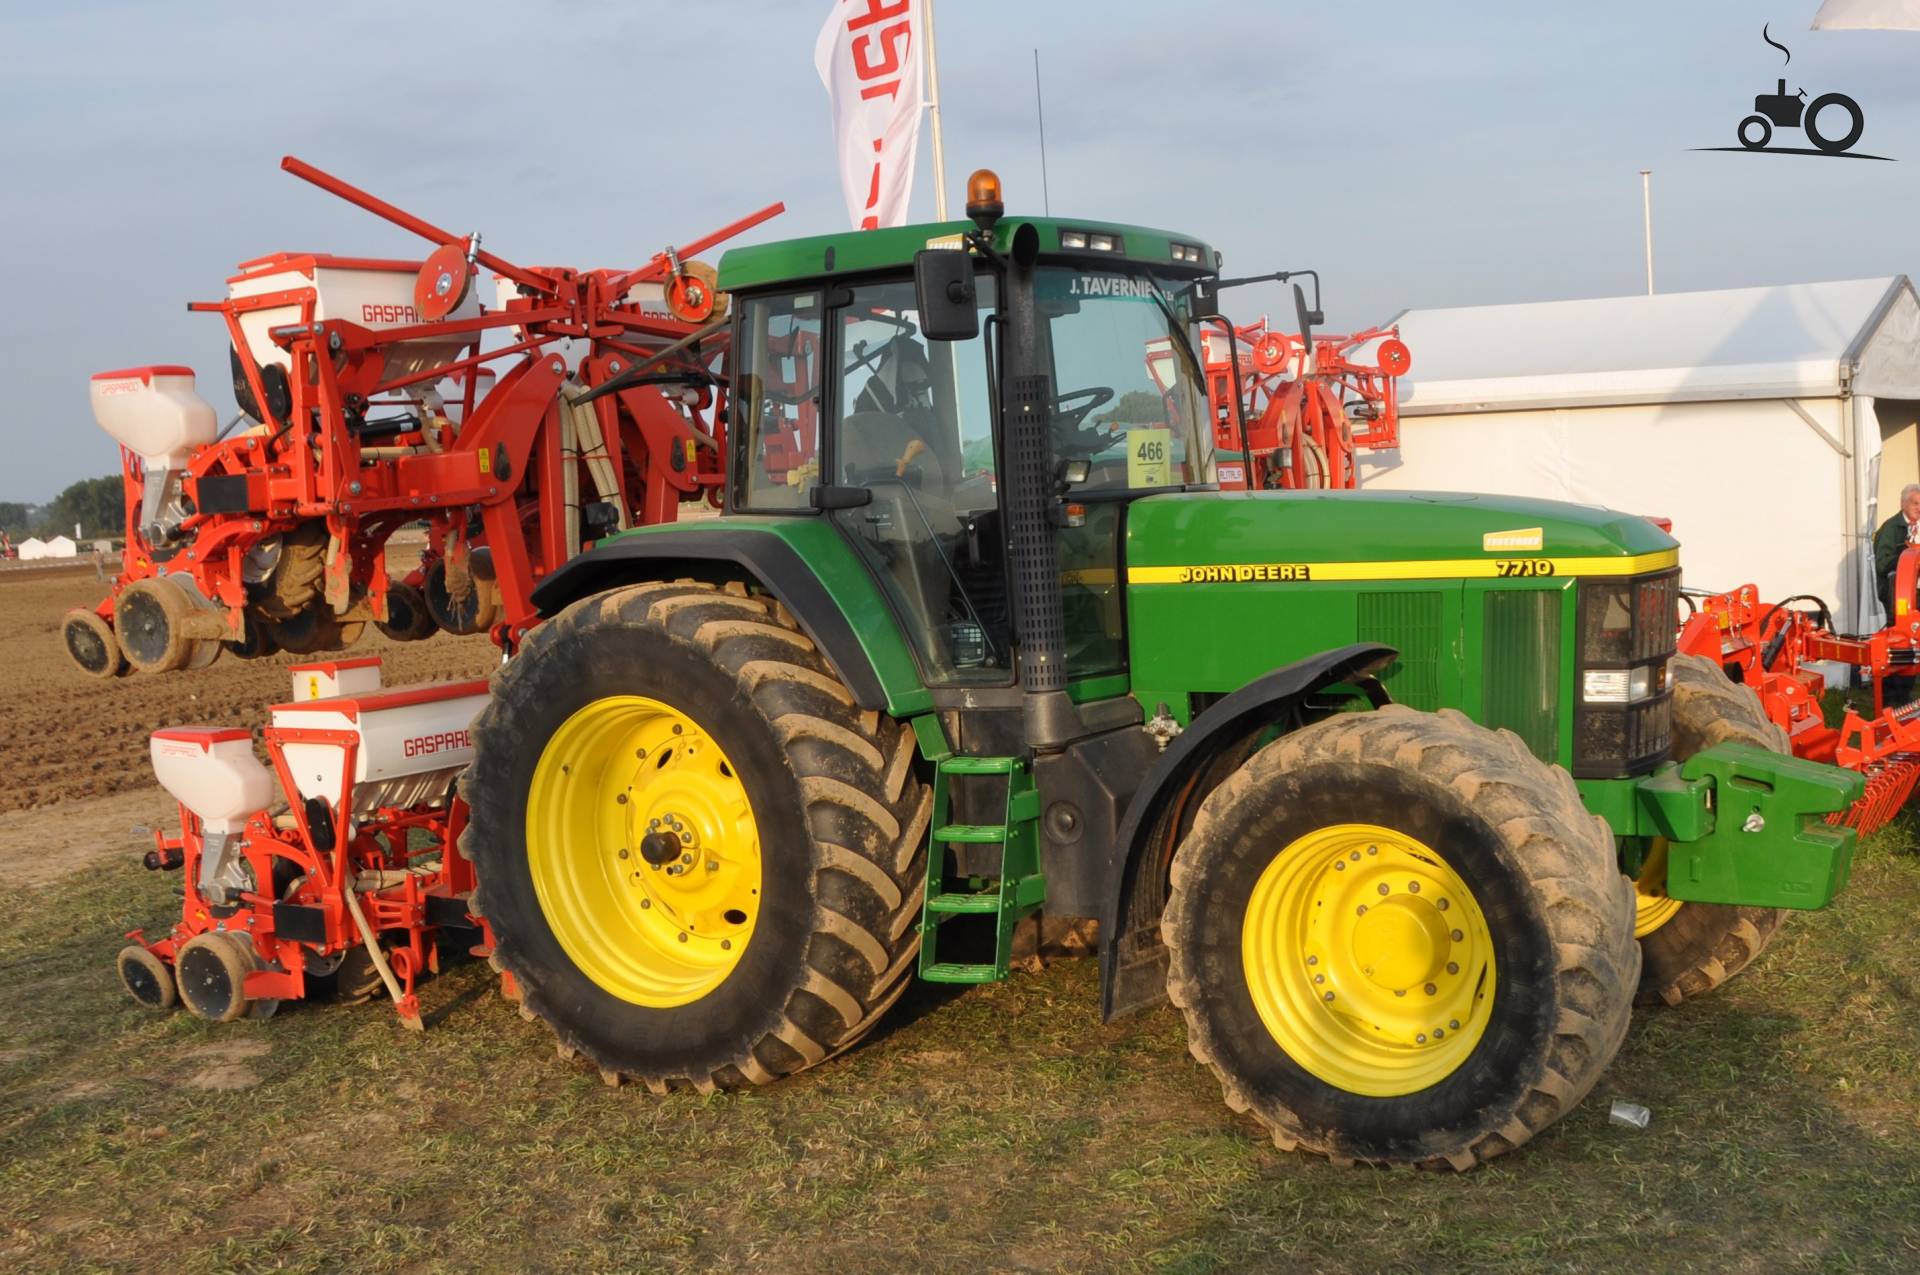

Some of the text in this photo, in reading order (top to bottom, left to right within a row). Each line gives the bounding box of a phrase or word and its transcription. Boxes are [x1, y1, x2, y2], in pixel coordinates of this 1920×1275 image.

[1069, 279, 1080, 294] J.
[1081, 277, 1157, 298] TAVERNIE
[362, 304, 445, 324] GASPA
[1137, 441, 1163, 461] 466
[1180, 564, 1311, 583] JOHN DEERE
[1495, 559, 1555, 578] 7710
